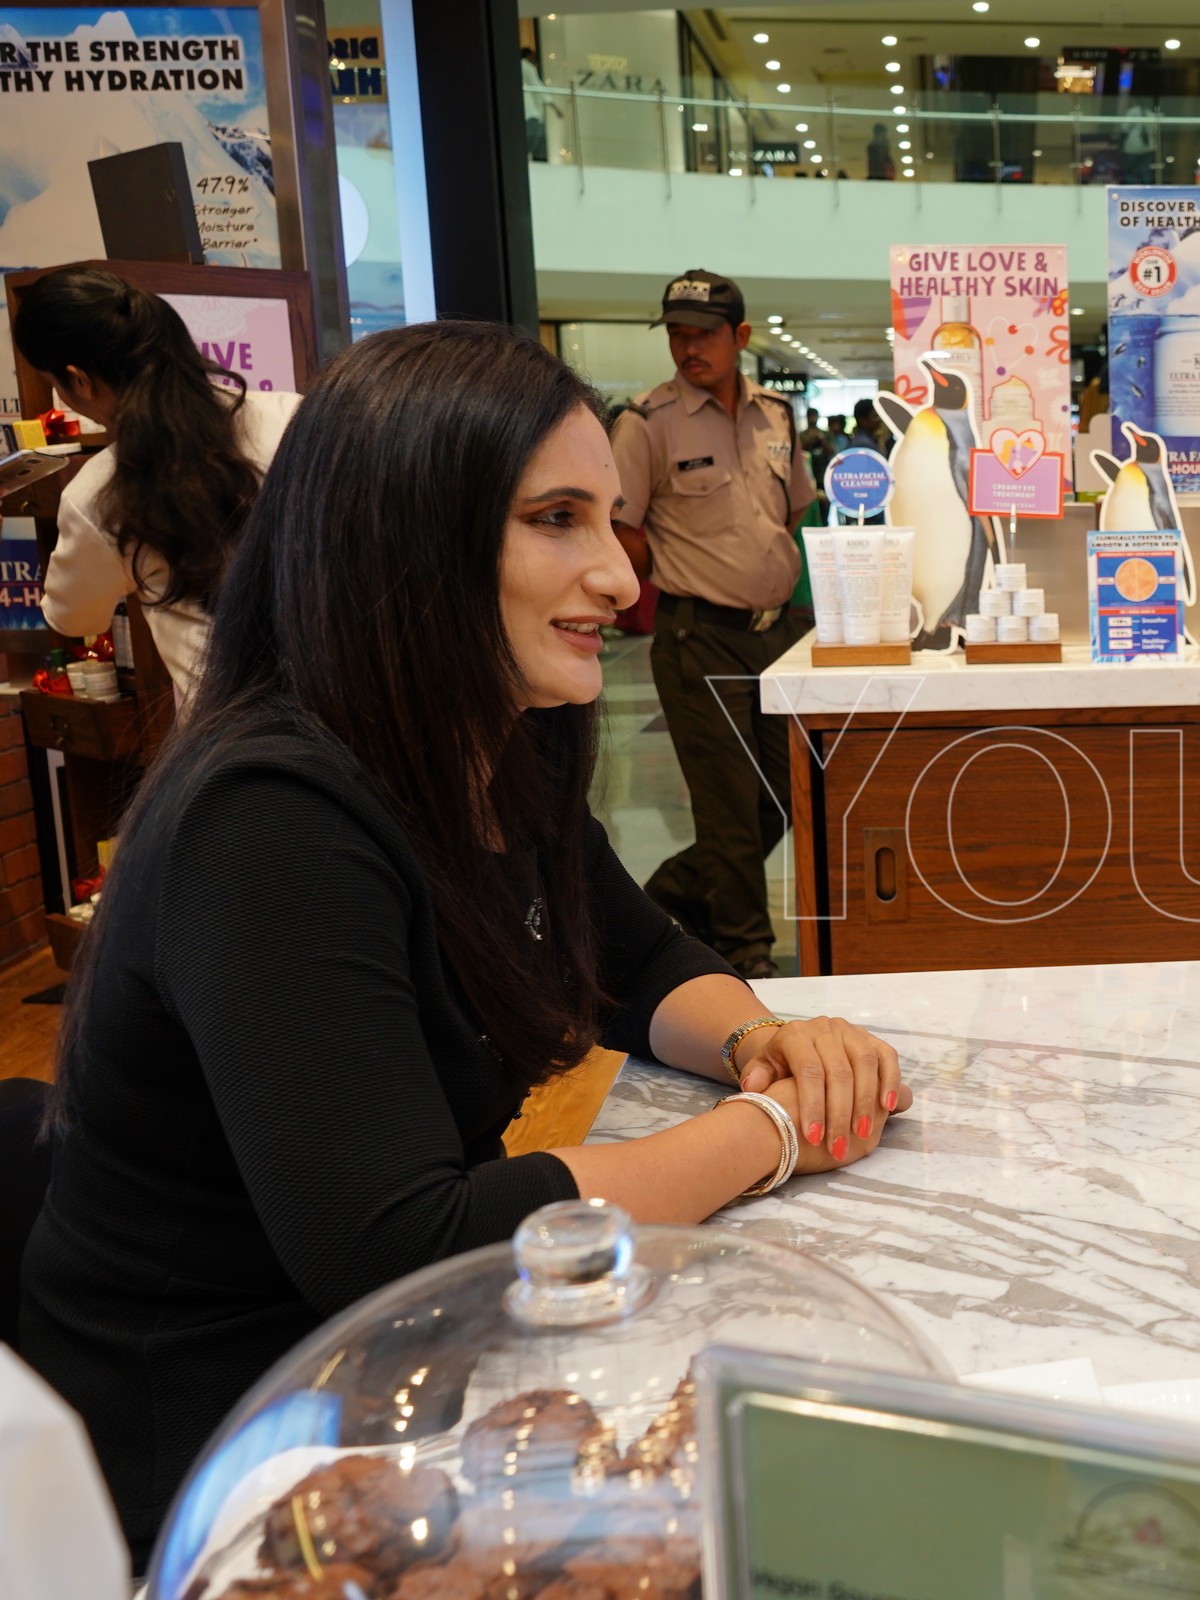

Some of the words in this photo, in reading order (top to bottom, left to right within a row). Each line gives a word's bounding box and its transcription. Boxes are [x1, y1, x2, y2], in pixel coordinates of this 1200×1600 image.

[26, 41, 81, 63] THE
[89, 39, 242, 62] STRENGTH
[64, 69, 244, 92] HYDRATION
[577, 70, 666, 93] ZARA
[753, 149, 797, 162] ZARA
[196, 175, 249, 195] 47.9%
[1120, 201, 1195, 213] DISCOVER
[1120, 216, 1140, 228] OF
[908, 251, 959, 272] GIVE
[967, 251, 1027, 272] LOVE
[1034, 252, 1048, 273] &
[1143, 266, 1161, 283] #1
[900, 276, 996, 297] HEALTHY
[1004, 276, 1059, 297] SKIN
[201, 341, 253, 370] IVE
